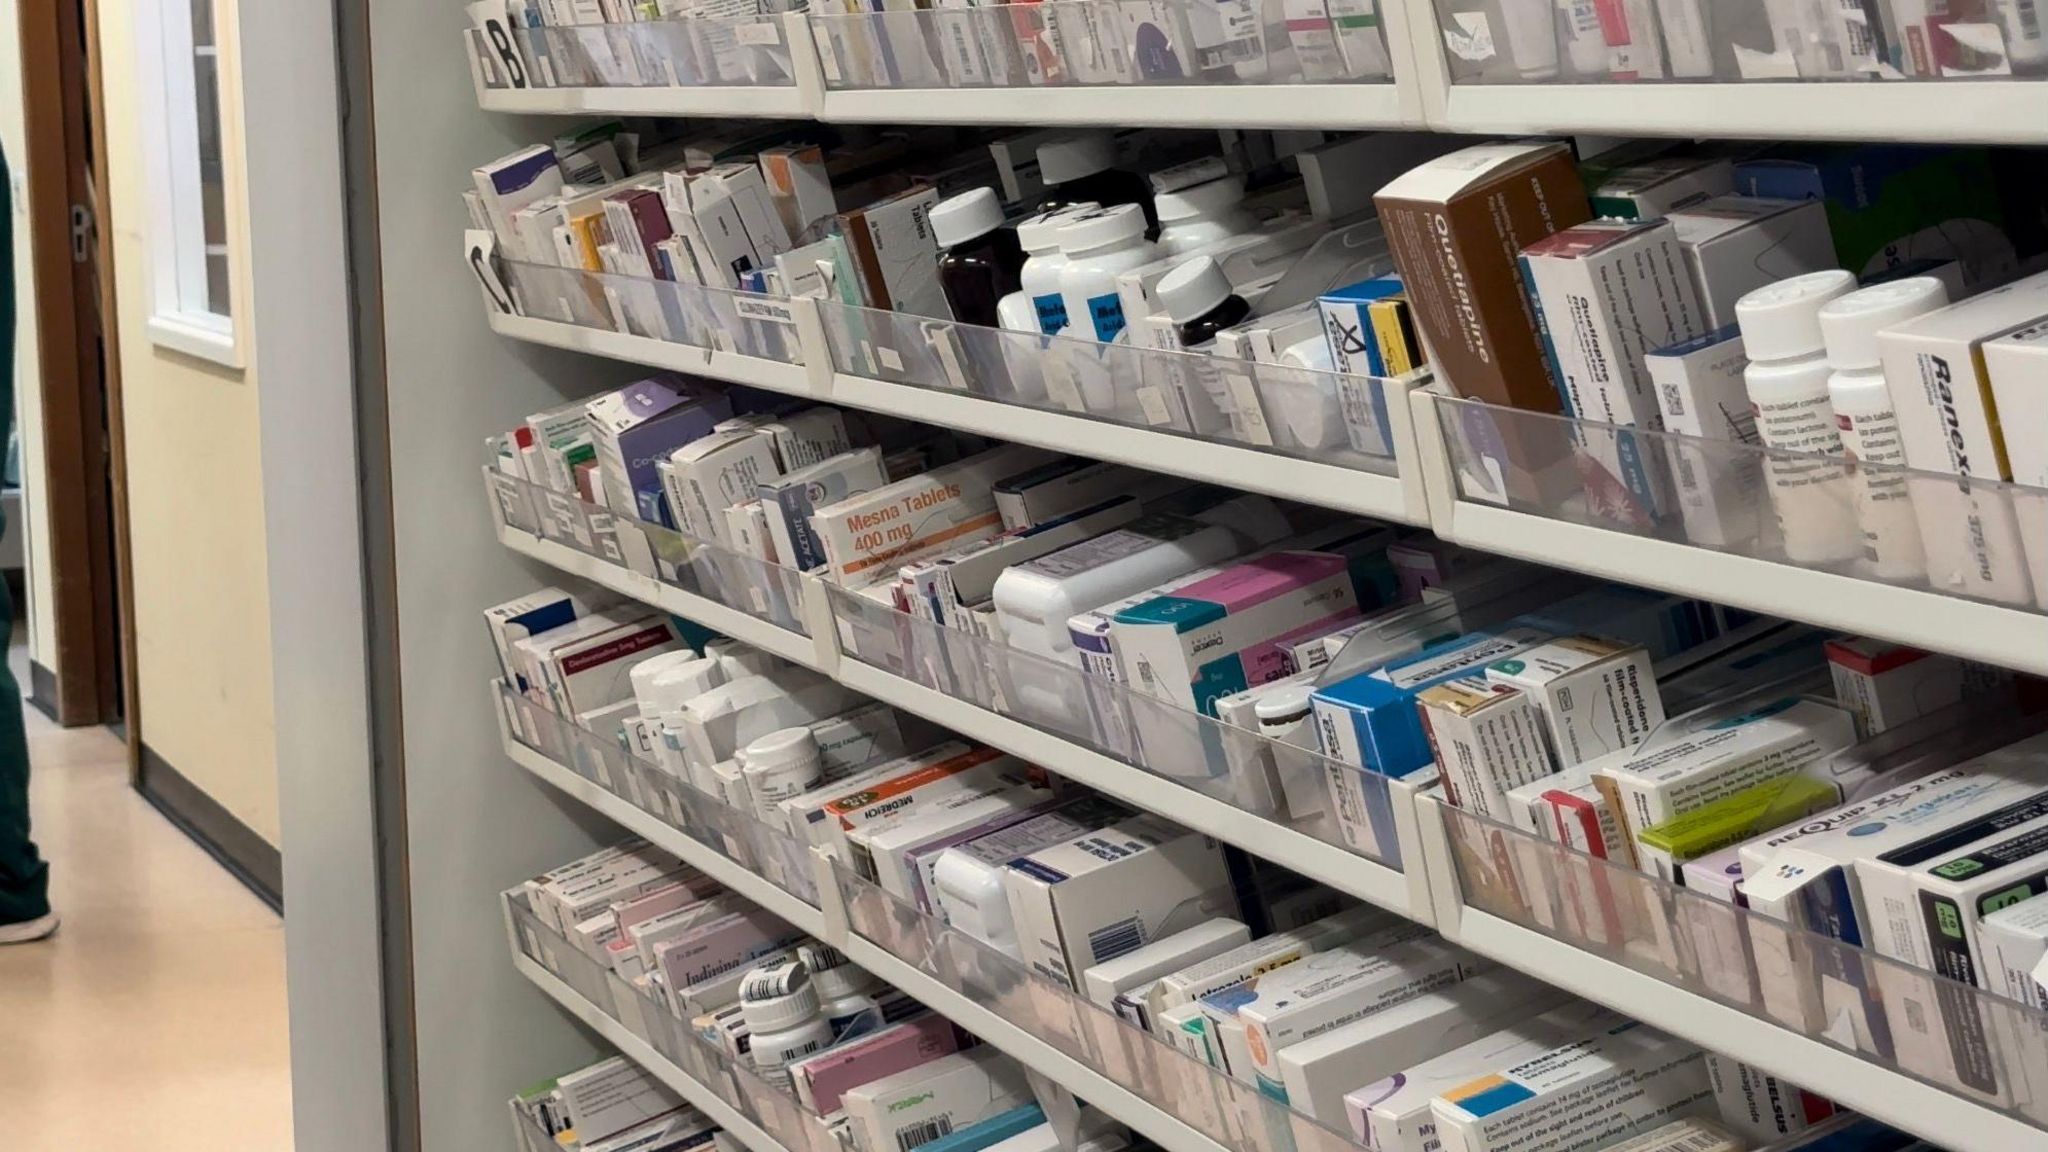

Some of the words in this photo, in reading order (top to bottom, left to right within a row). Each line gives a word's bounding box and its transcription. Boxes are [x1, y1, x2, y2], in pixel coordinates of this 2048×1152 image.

[909, 205, 928, 240] Tablets
[1432, 212, 1491, 365] Quetiapine
[1576, 295, 1612, 384] Quetiapine
[845, 502, 902, 534] Mesna
[899, 480, 963, 514] Tablets
[851, 529, 885, 553] 400
[885, 522, 914, 545] mg
[1612, 667, 1639, 735] film-coated
[1623, 663, 1652, 732] Risperidone
[1317, 715, 1353, 823] Pentasa
[862, 793, 914, 819] MEDREICH
[1766, 803, 1867, 849] REQUIP
[1927, 766, 1967, 788] mg
[683, 955, 743, 987] Indivina
[1521, 1045, 1605, 1080] semaglutide
[1481, 1120, 1504, 1135] Each
[1501, 1111, 1527, 1127] tablet
[1523, 1099, 1559, 1119] contains
[1484, 1123, 1521, 1143] Contains
[1562, 1094, 1597, 1115] package
[1593, 1084, 1621, 1101] leaflet
[1631, 1068, 1660, 1085] further
[1488, 1141, 1512, 1152] Keep
[1509, 1135, 1526, 1149] out
[1533, 1125, 1549, 1138] the
[1546, 1117, 1570, 1133] sight
[1567, 1110, 1585, 1124] and
[1582, 1102, 1606, 1118] reach
[1613, 1086, 1646, 1106] children
[1593, 1122, 1627, 1143] package
[1764, 1074, 1788, 1135] BELSUS
[1526, 1136, 1560, 1152] package
